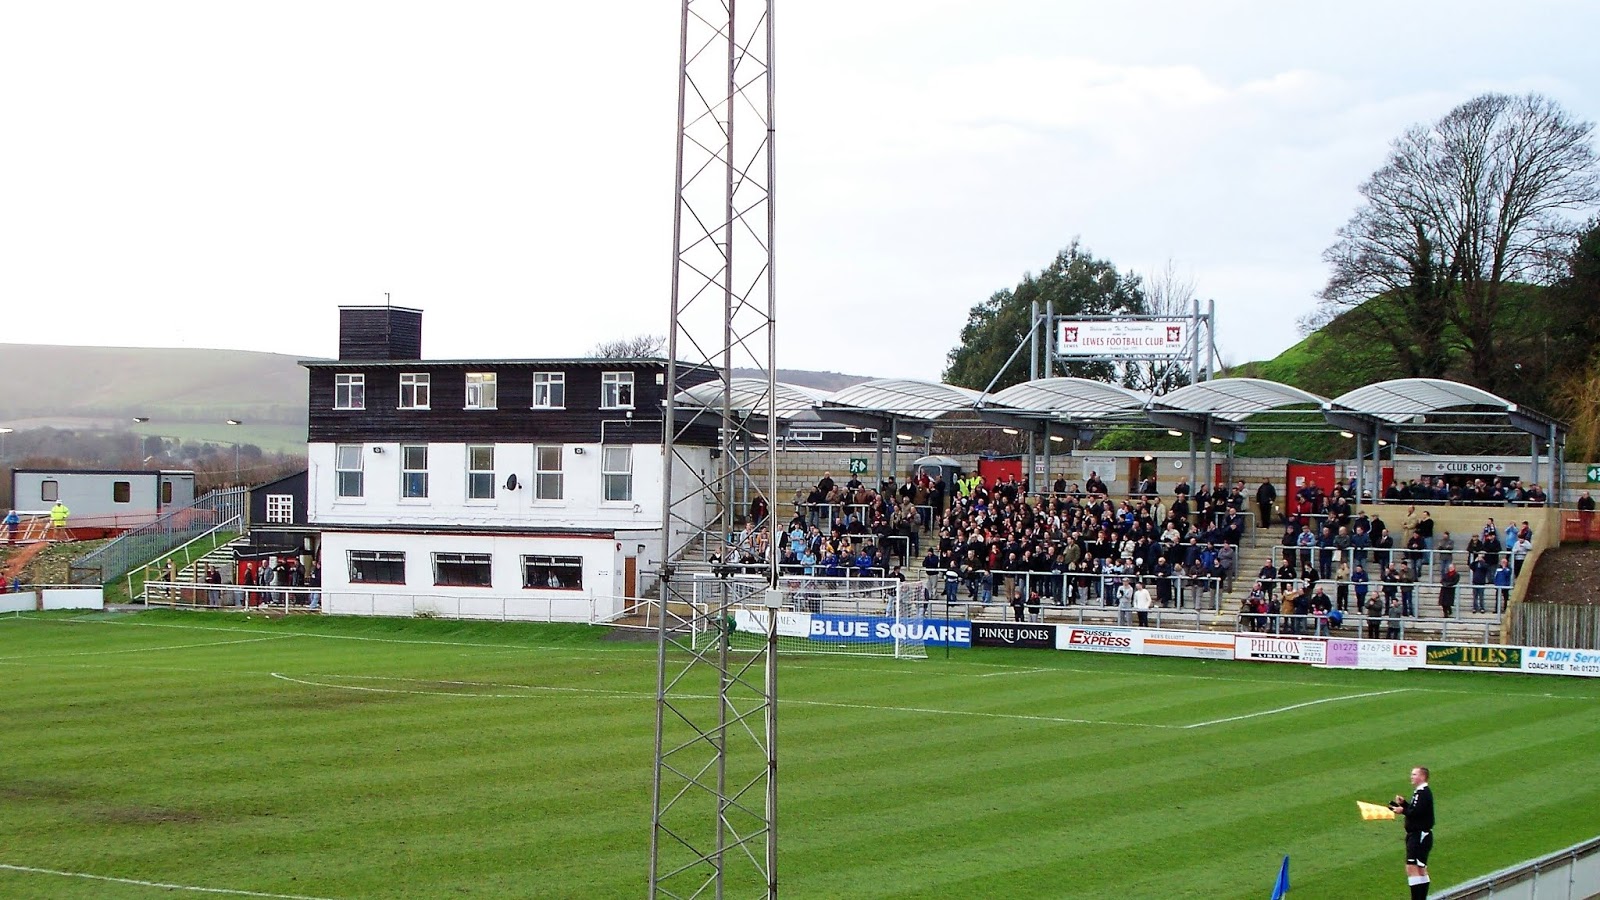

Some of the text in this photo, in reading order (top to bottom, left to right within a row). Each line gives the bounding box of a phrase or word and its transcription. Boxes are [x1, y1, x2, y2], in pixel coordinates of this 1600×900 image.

[1082, 337, 1164, 346] LEWES FOOTBALL CLUB
[1446, 463, 1494, 472] CLUB SHOP
[811, 620, 971, 642] BLUE SQUARE
[979, 627, 1049, 643] PINKIE JONES
[1084, 629, 1113, 637] SUSSEX
[1069, 629, 1132, 647] EXPRESS
[1251, 639, 1300, 654] PHILCOX
[1333, 643, 1358, 652] 01273
[1361, 643, 1391, 652] 476758
[1427, 646, 1507, 663] Master TILES
[1546, 650, 1571, 662] RDH
[1528, 662, 1549, 670] COACH
[1549, 663, 1565, 671] HIRE
